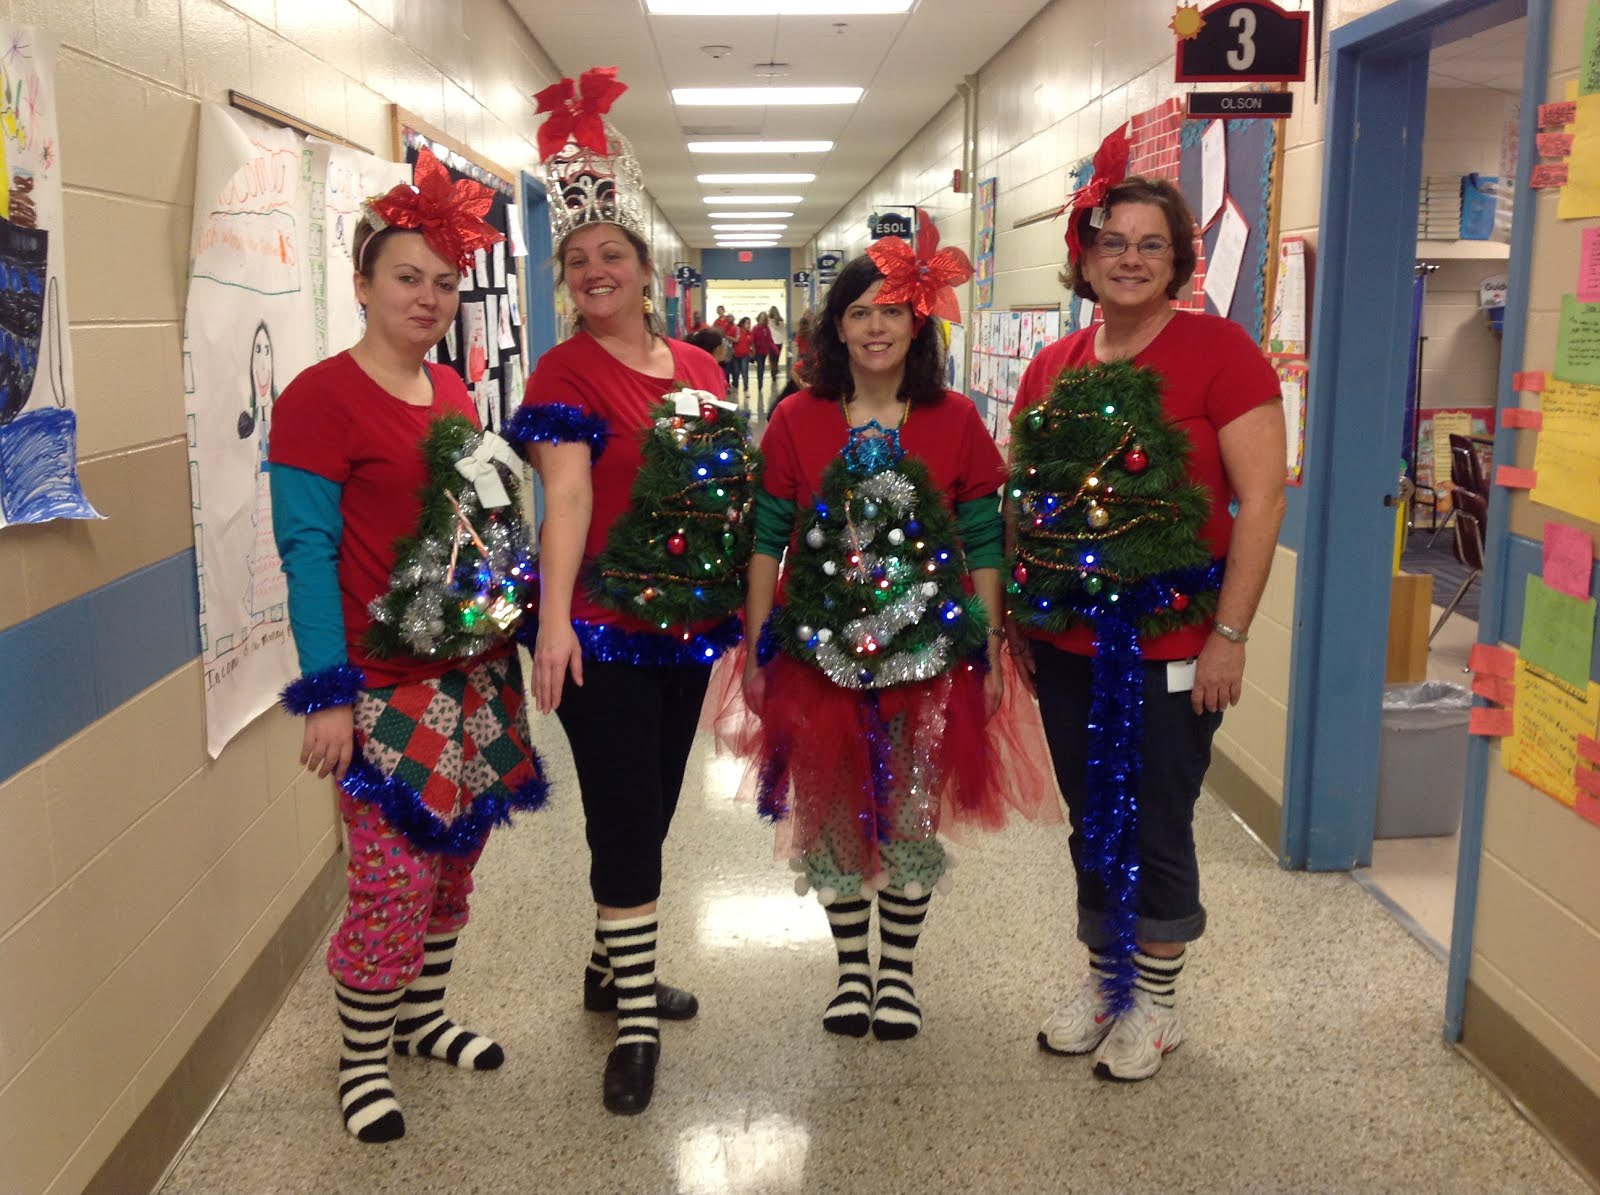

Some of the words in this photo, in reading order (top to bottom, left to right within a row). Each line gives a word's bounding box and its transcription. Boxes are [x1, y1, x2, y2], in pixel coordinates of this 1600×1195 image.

[1226, 7, 1257, 71] 3
[1220, 97, 1262, 109] OLSON
[875, 222, 907, 233] ESOL
